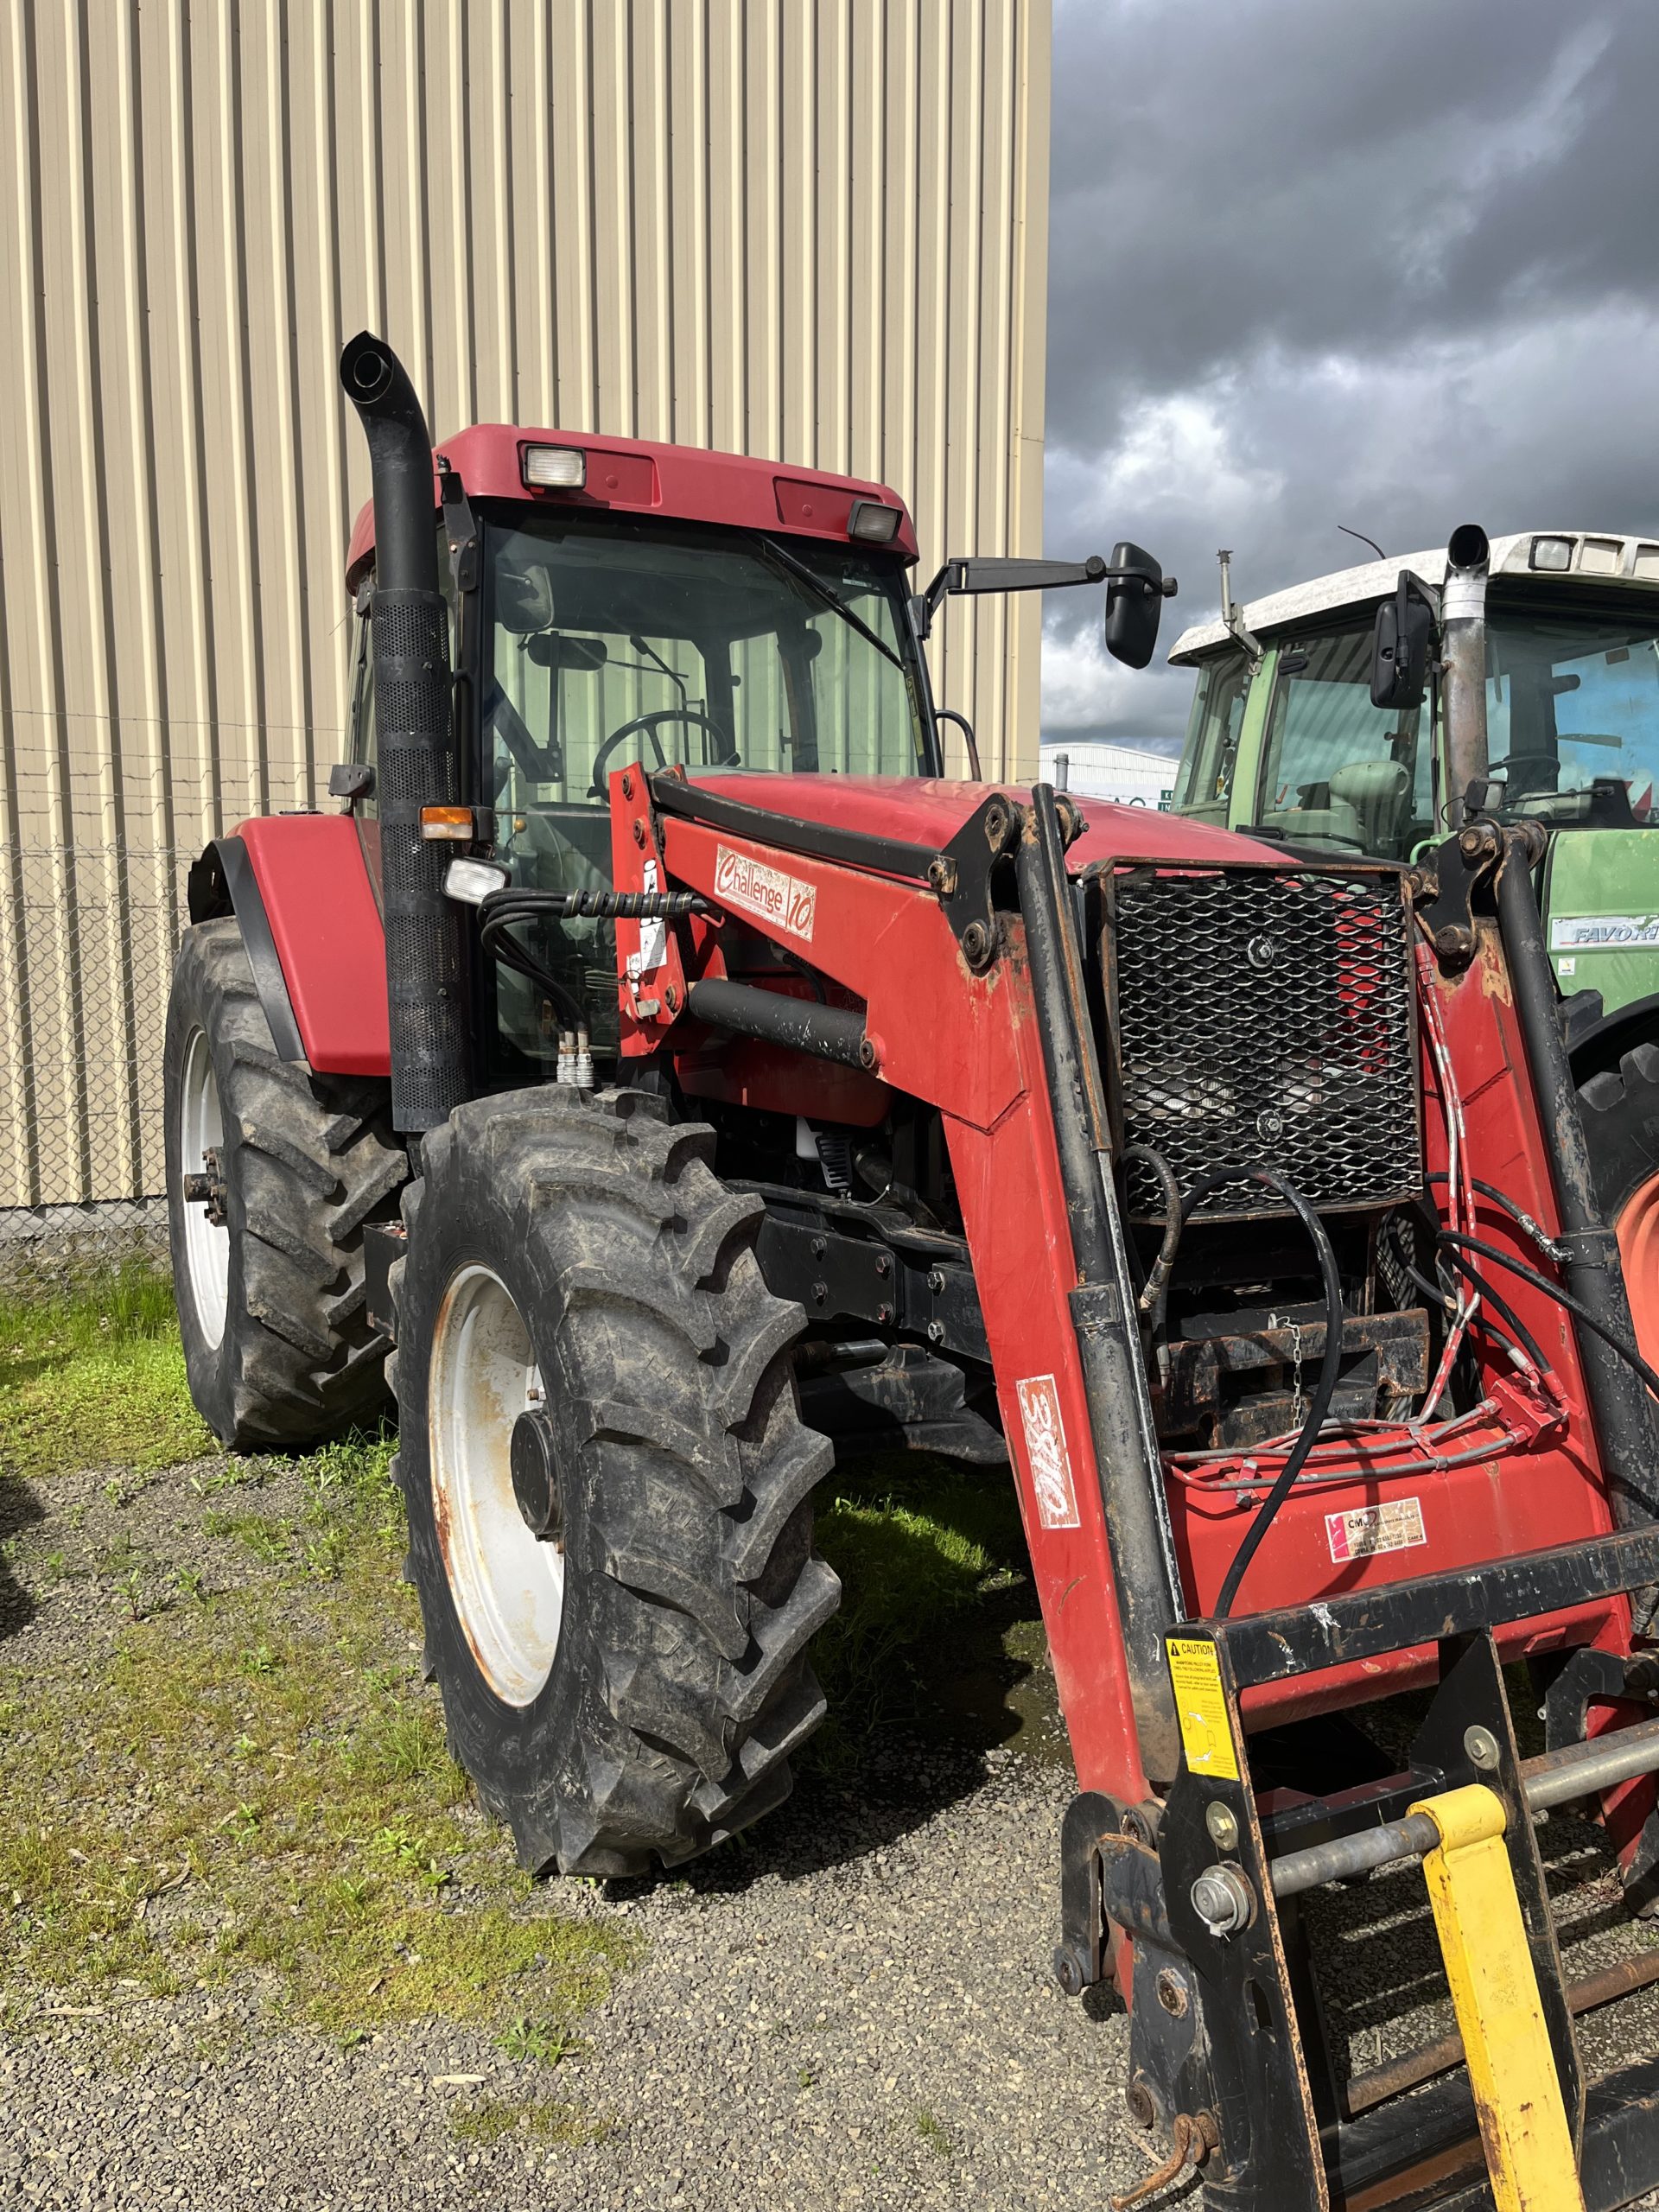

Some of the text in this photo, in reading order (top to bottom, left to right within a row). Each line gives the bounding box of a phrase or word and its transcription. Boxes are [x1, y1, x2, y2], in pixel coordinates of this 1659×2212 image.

[717, 853, 783, 913] Challenge
[788, 893, 812, 931] 10
[1181, 1643, 1214, 1656] CAUTION
